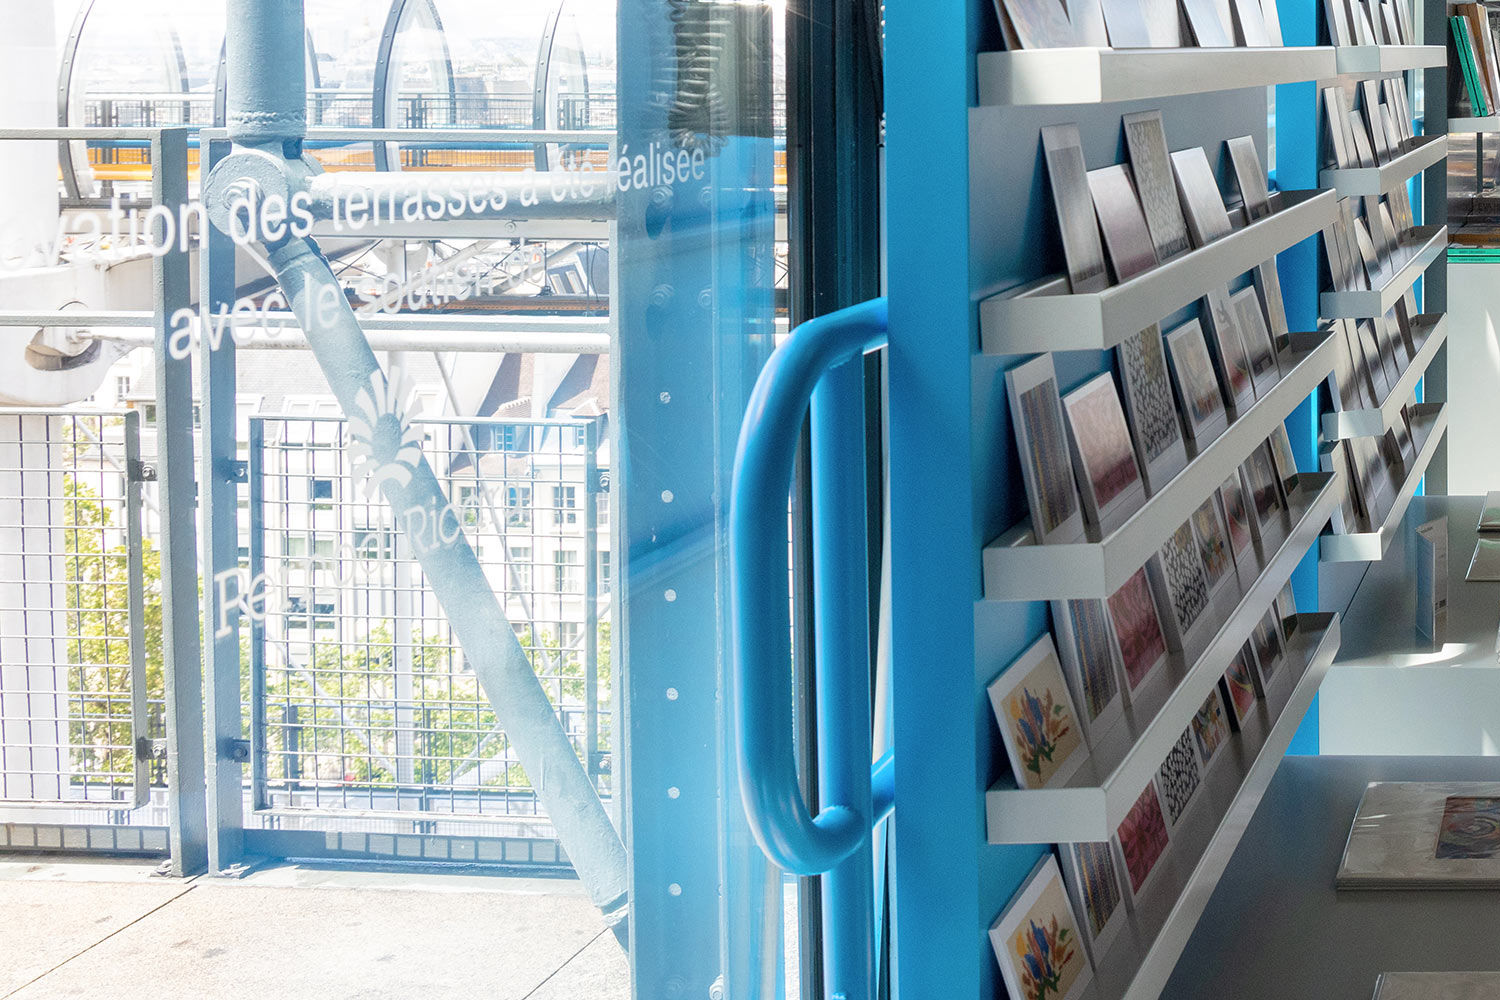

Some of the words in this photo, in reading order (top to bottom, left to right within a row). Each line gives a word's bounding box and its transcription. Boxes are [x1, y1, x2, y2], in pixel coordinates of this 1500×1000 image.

[230, 181, 315, 246] des
[331, 171, 508, 232] terrasses
[519, 167, 539, 207] a
[550, 142, 595, 204] été
[606, 137, 705, 194] réalisée
[169, 291, 287, 361] avec
[304, 271, 341, 333] le
[354, 253, 495, 318] soutien
[214, 514, 387, 640] Pernod
